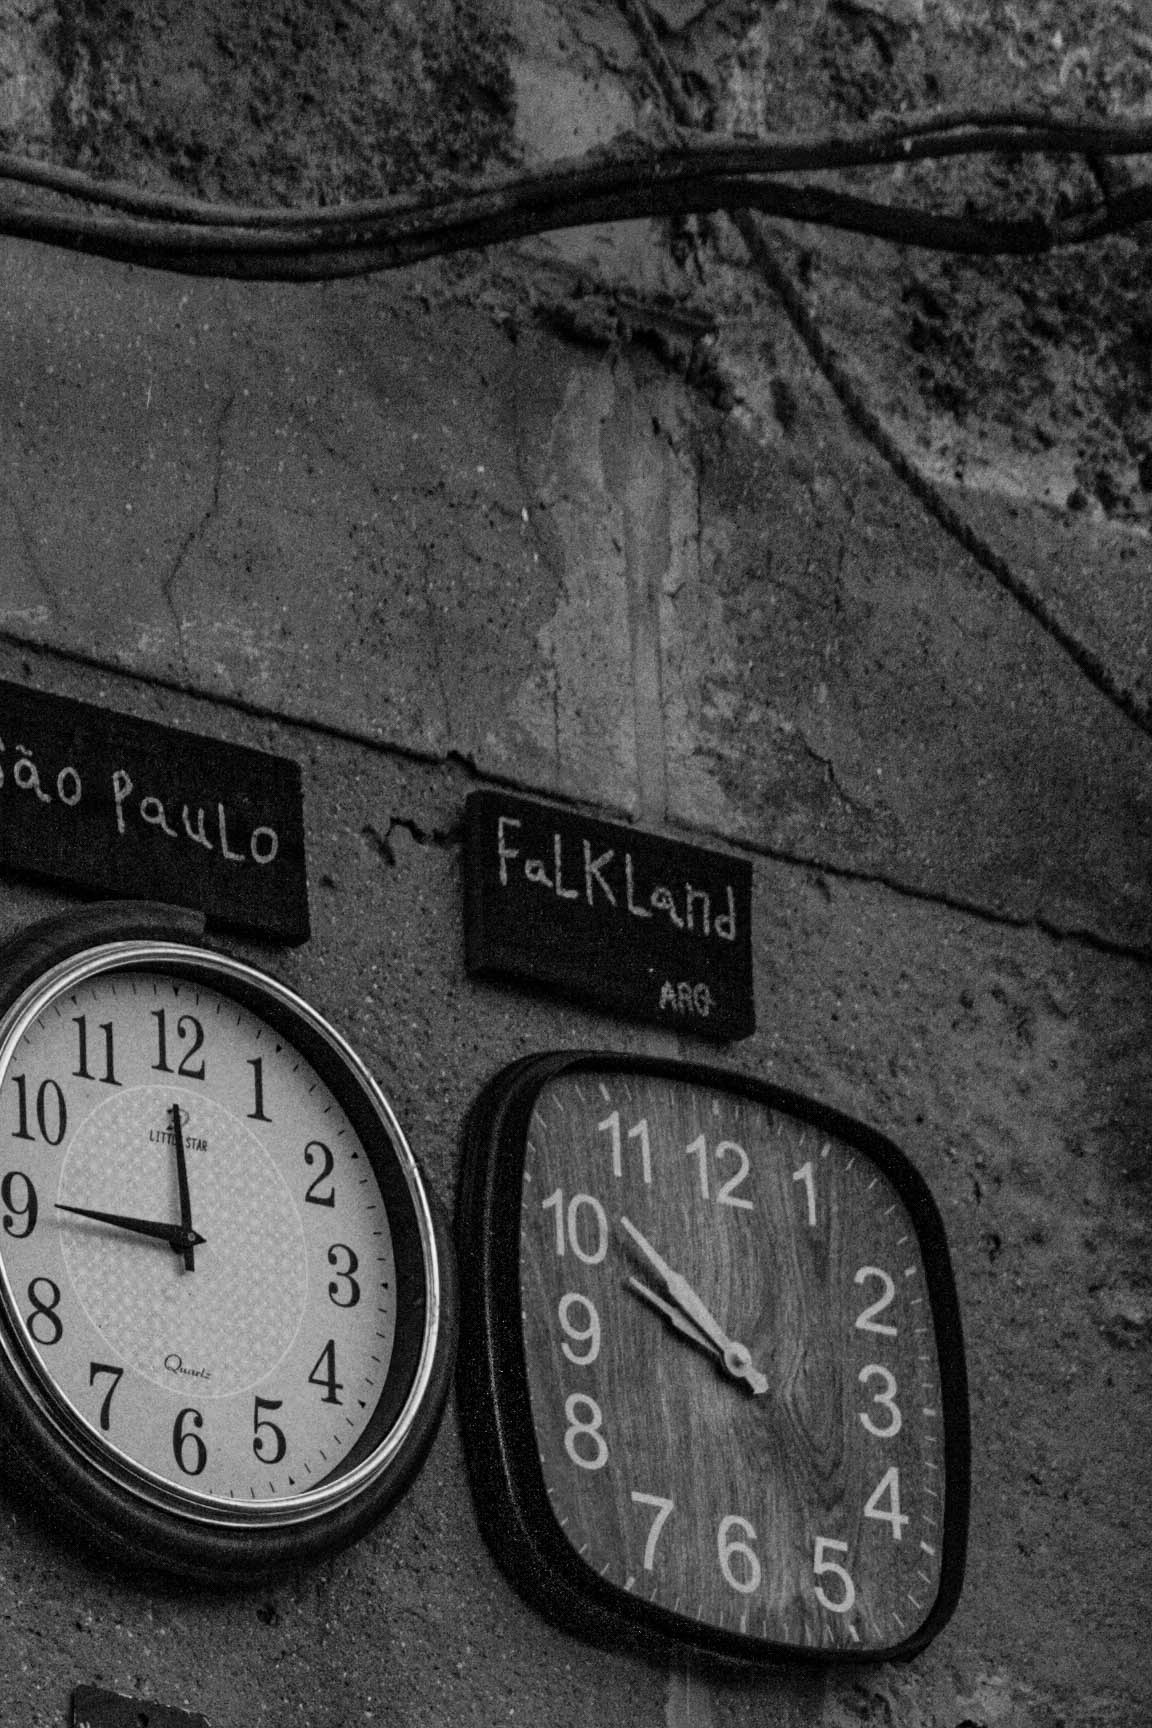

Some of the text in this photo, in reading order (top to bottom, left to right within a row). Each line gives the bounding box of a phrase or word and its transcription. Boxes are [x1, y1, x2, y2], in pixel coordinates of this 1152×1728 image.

[72, 1014, 123, 1087] 11
[151, 1008, 206, 1081] 12
[11, 1073, 67, 1146] 10
[246, 1057, 273, 1123] 1
[185, 1136, 208, 1152] STAR
[304, 1140, 336, 1208] 2
[598, 1111, 652, 1184] 11
[686, 1134, 754, 1210] 12
[1, 1171, 38, 1239] 9
[543, 1188, 609, 1265] 10
[793, 1161, 817, 1227] 1
[26, 1276, 63, 1345] 8
[327, 1243, 361, 1308] 3
[854, 1265, 898, 1336] 2
[558, 1292, 600, 1365] 9
[89, 1361, 124, 1431] 7
[163, 1353, 212, 1380] Quartz
[308, 1338, 344, 1406] 4
[857, 1364, 902, 1437] 3
[172, 1407, 207, 1475] 6
[252, 1396, 287, 1464] 5
[563, 1392, 609, 1470] 8
[631, 1491, 675, 1570] 7
[864, 1465, 910, 1540] 4
[717, 1514, 762, 1593] 6
[812, 1535, 856, 1613] 5
